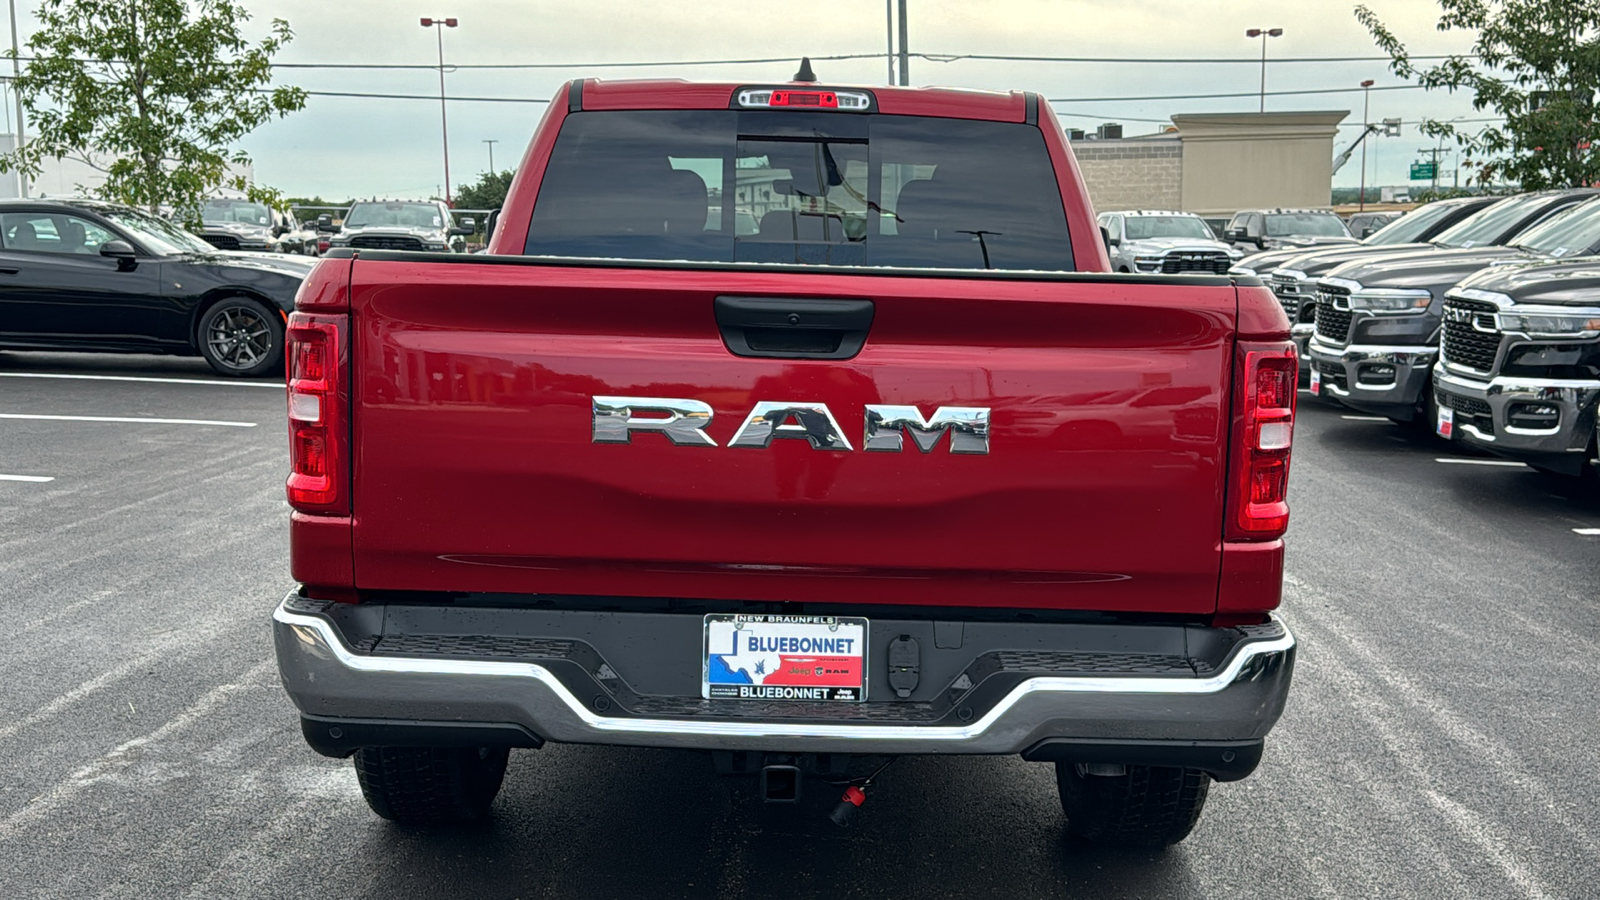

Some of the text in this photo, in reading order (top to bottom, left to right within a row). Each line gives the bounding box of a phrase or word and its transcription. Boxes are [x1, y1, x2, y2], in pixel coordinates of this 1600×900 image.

[592, 395, 991, 455] RAM
[738, 615, 834, 624] NEW BRAUNFELS
[748, 636, 854, 654] BLUEBONNET
[788, 667, 811, 676] Jeep
[740, 686, 830, 699] BLUEBONNET
